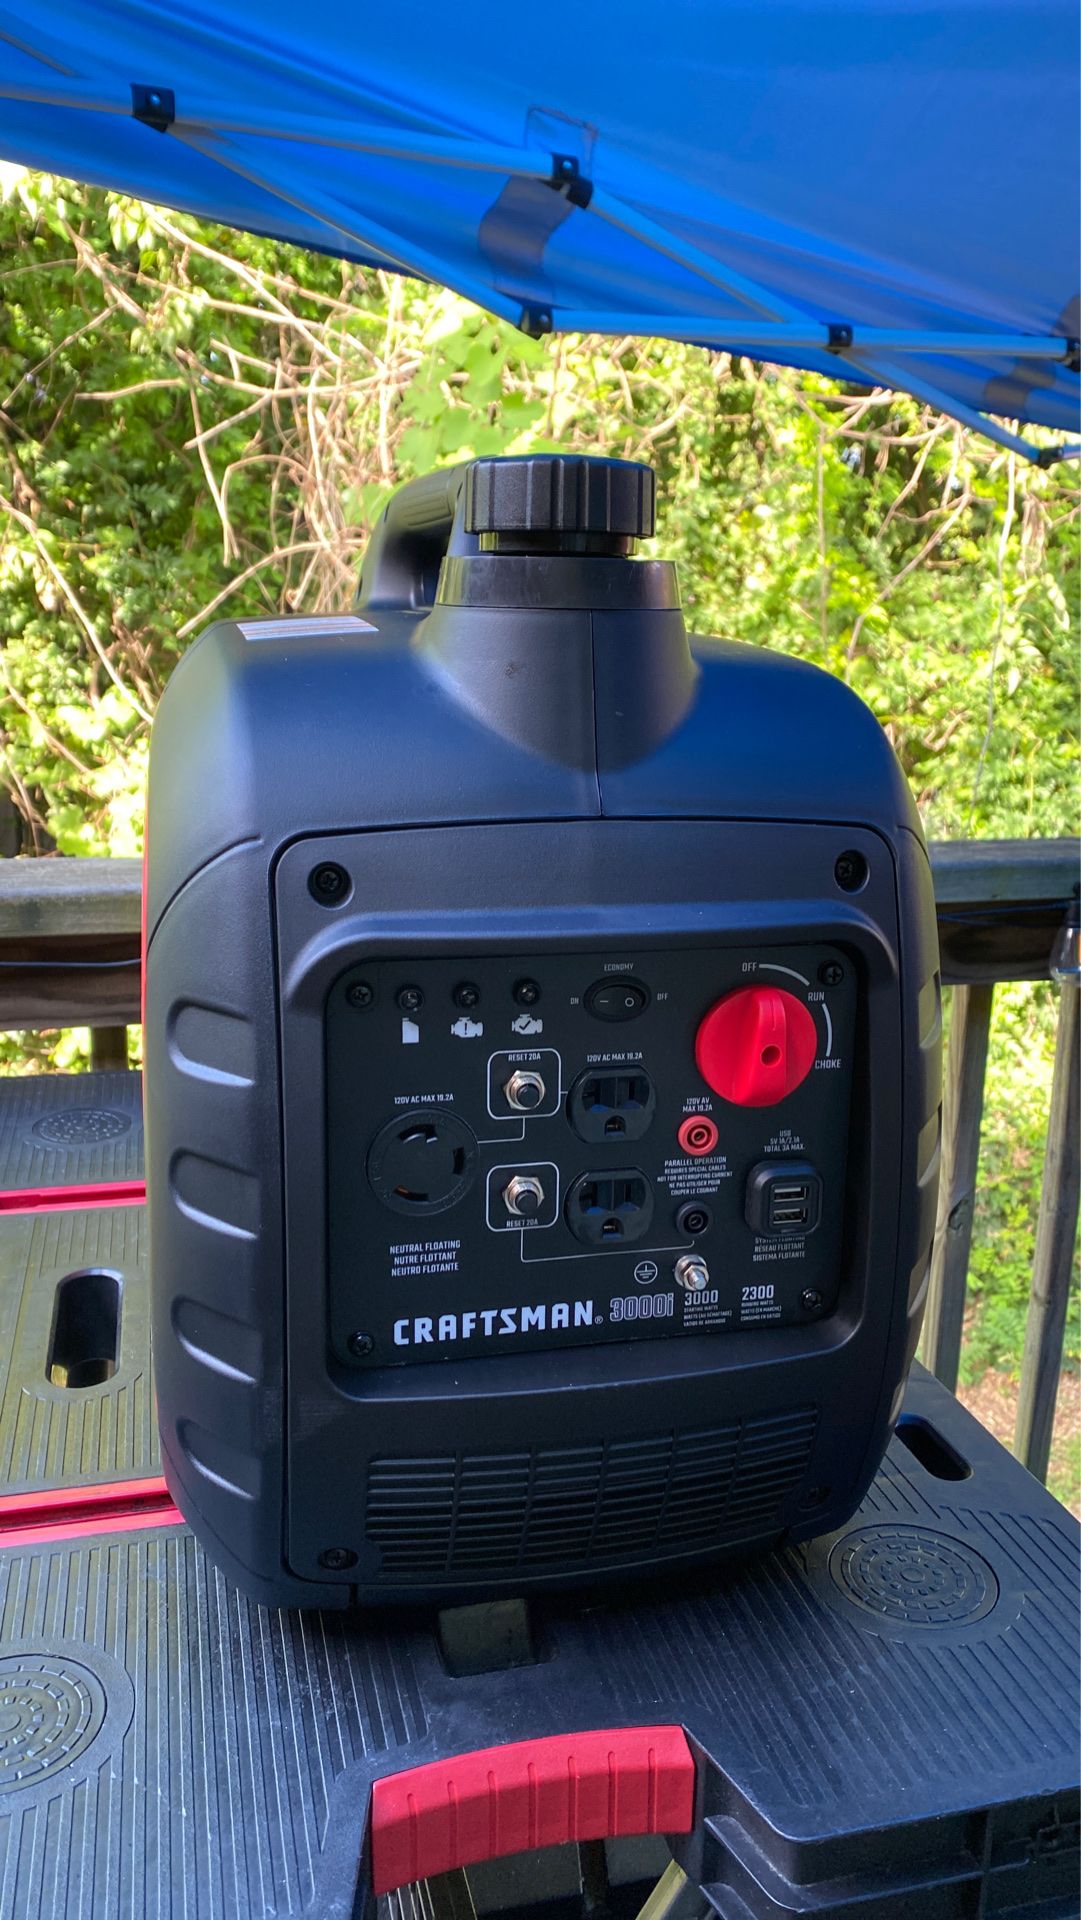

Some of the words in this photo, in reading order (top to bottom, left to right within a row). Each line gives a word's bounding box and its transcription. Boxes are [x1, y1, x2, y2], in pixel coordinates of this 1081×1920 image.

[604, 963, 634, 972] ECONOMY
[742, 962, 758, 972] OFF
[570, 997, 579, 1005] ON
[808, 992, 825, 1001] RUN
[508, 1053, 528, 1062] RESET
[529, 1052, 541, 1060] 20A
[587, 1054, 601, 1062] 120V
[602, 1054, 611, 1062] AC
[612, 1053, 626, 1061] MAX
[815, 1059, 841, 1069] CHOKE
[664, 1158, 693, 1167] PARALLEL
[694, 1156, 727, 1165] OPERATION
[678, 1173, 711, 1181] INTERRUPTING
[696, 1186, 718, 1194] COURANT
[506, 1220, 526, 1228] RESET
[526, 1218, 538, 1226] 20A
[390, 1243, 423, 1254] NEUTRAL
[425, 1240, 461, 1251] FLOATING
[777, 1242, 805, 1251] FLOTTANT
[394, 1255, 419, 1265] NUTRE
[420, 1251, 456, 1263] FLOTTANT
[753, 1253, 777, 1262] SISTEMA
[778, 1251, 805, 1260] FLOTANTE
[392, 1266, 421, 1277] NEUTRO
[422, 1262, 459, 1273] FLOTANTE
[742, 1285, 774, 1300] 2300
[685, 1290, 718, 1306] 3000
[610, 1293, 674, 1321] 3000i
